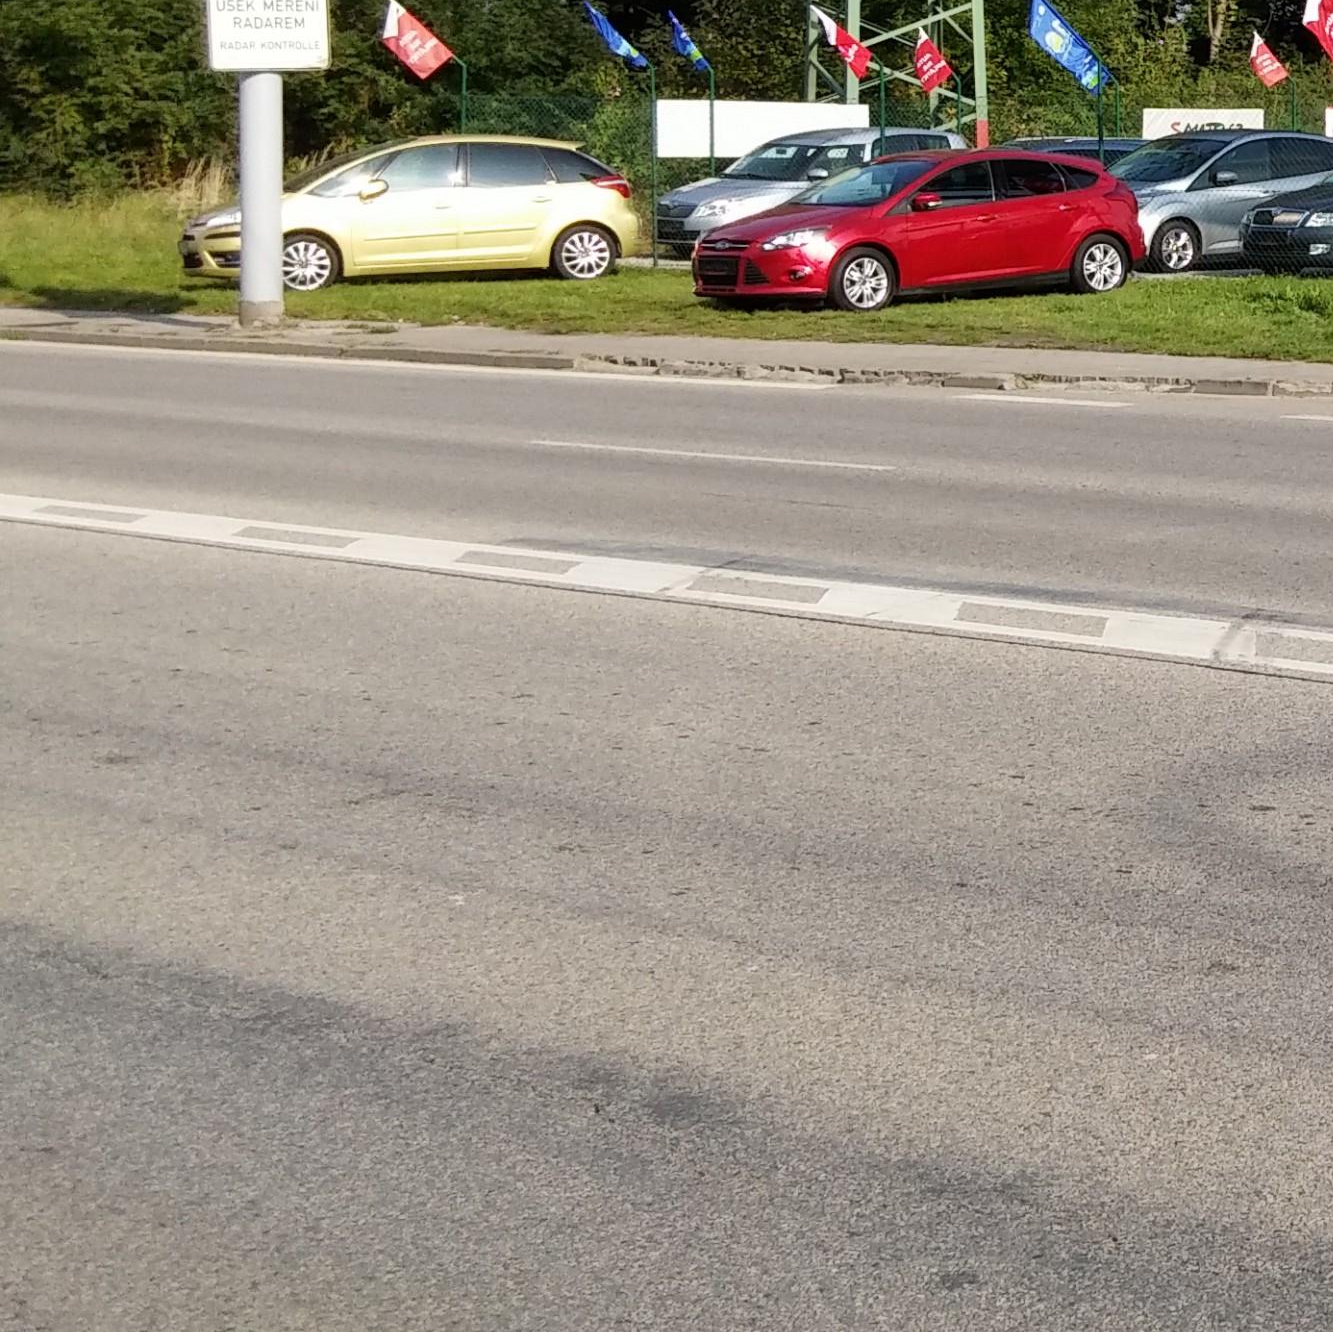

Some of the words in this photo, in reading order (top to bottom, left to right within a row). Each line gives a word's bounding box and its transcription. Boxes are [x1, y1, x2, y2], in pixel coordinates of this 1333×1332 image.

[233, 17, 305, 29] RADAREM
[220, 40, 256, 50] RADAR
[261, 40, 320, 50] KONTROLLE
